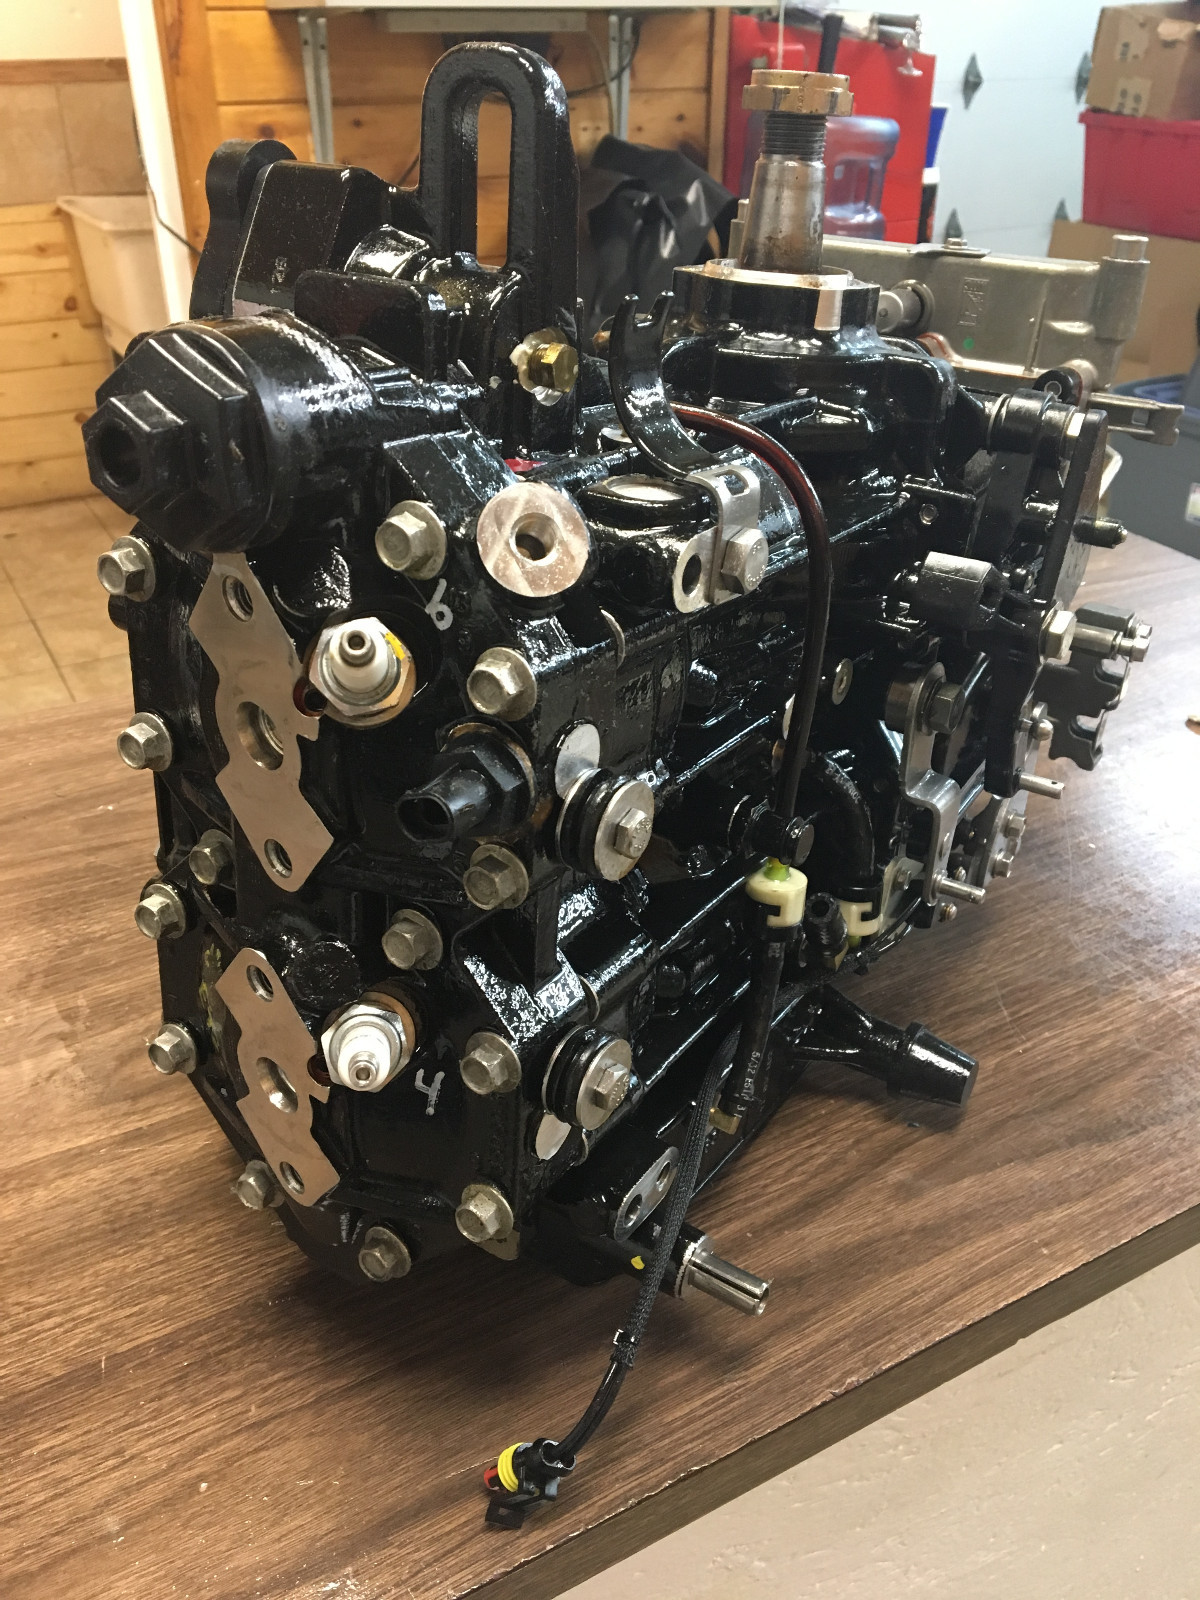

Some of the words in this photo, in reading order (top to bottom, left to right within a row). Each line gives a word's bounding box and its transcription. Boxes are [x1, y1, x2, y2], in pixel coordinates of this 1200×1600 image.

[424, 578, 454, 631] 6
[747, 1051, 761, 1074] 5/32
[414, 1068, 446, 1116] 4
